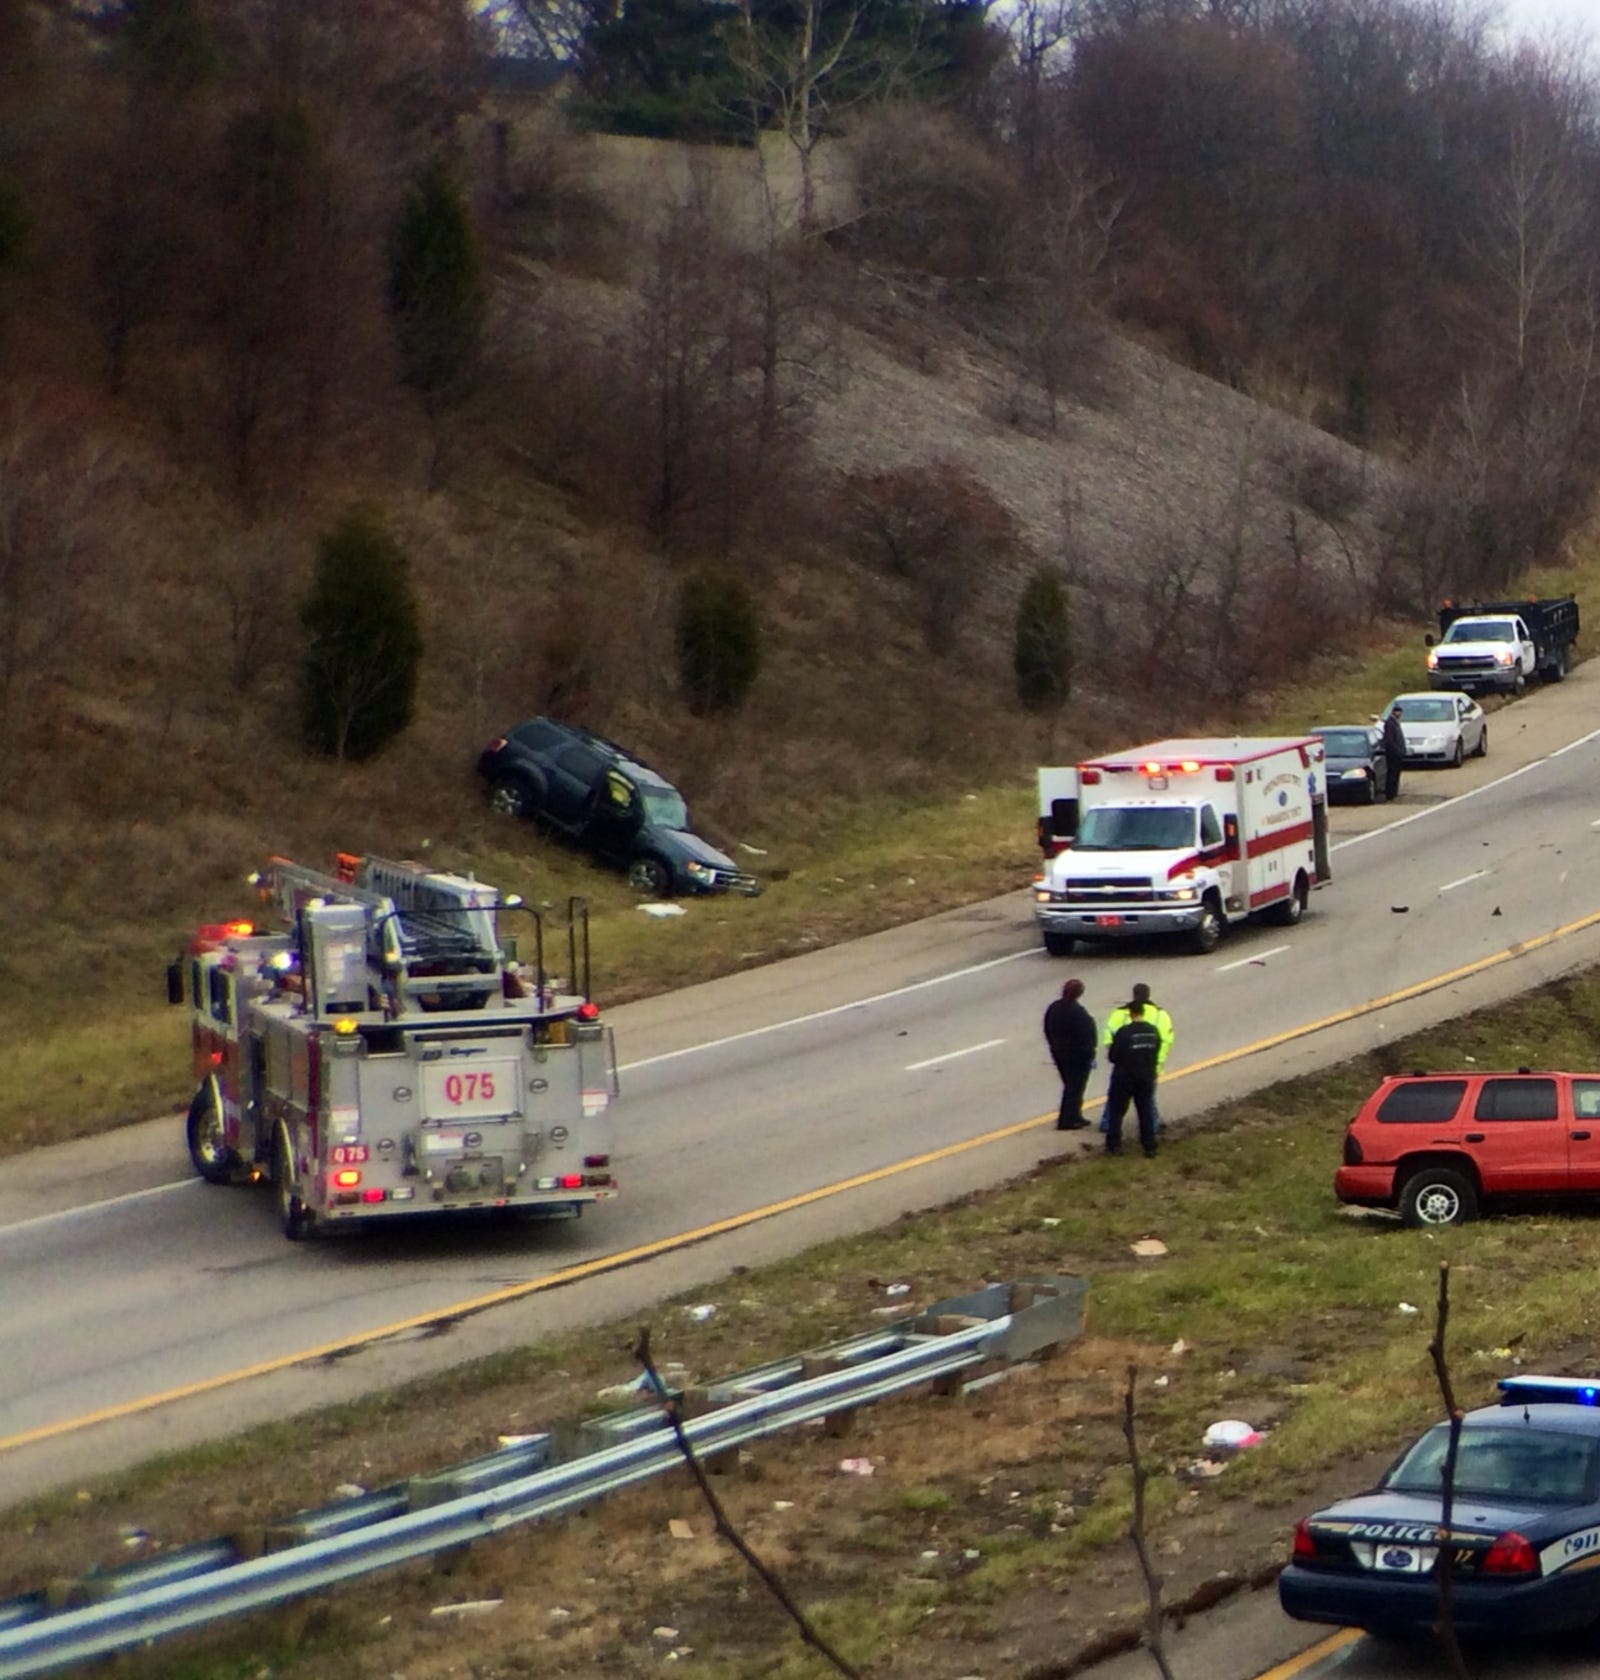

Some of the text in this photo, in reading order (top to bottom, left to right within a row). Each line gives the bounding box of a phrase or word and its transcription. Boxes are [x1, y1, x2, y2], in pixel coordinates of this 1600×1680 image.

[445, 1073, 495, 1105] Q75
[1348, 1523, 1438, 1541] POLICE
[1573, 1533, 1599, 1551] 911
